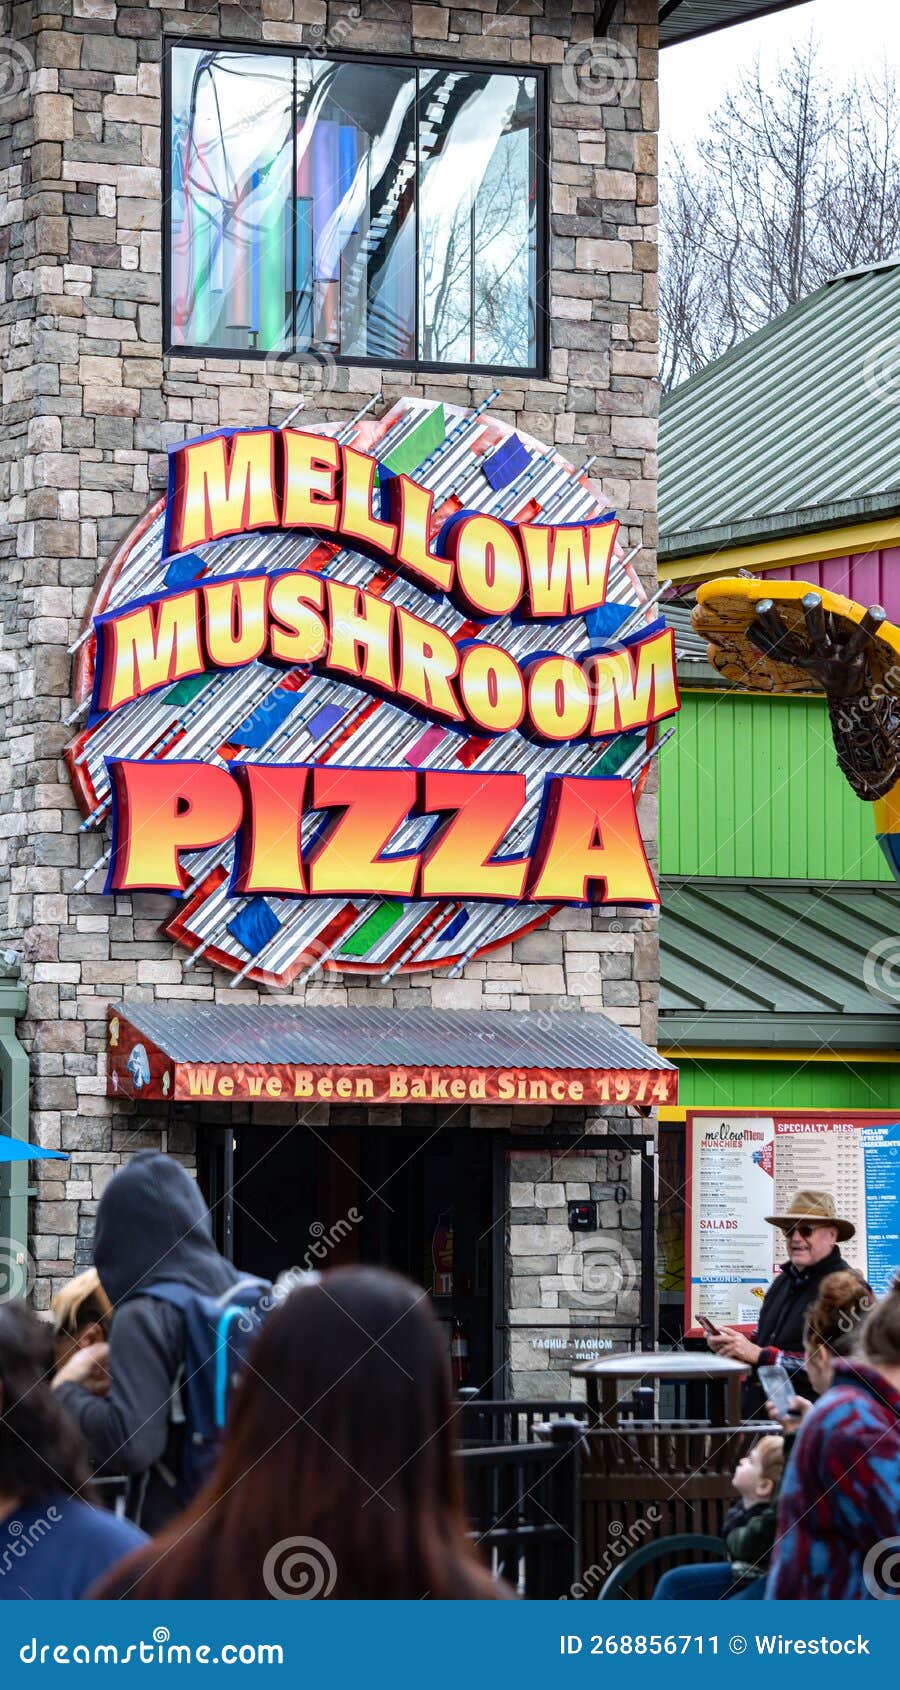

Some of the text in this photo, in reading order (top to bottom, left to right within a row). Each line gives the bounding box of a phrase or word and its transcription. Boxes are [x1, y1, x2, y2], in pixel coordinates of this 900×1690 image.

[172, 428, 620, 618] MELLOW
[102, 571, 681, 740] MUSHROOM
[112, 758, 660, 905] PIZZA
[186, 1068, 669, 1101] We've Been Baked Since 1974
[700, 1140, 743, 1148] MUNCHIES
[778, 1123, 854, 1132] SPECIALTY PIES
[699, 1220, 738, 1229] SALADS
